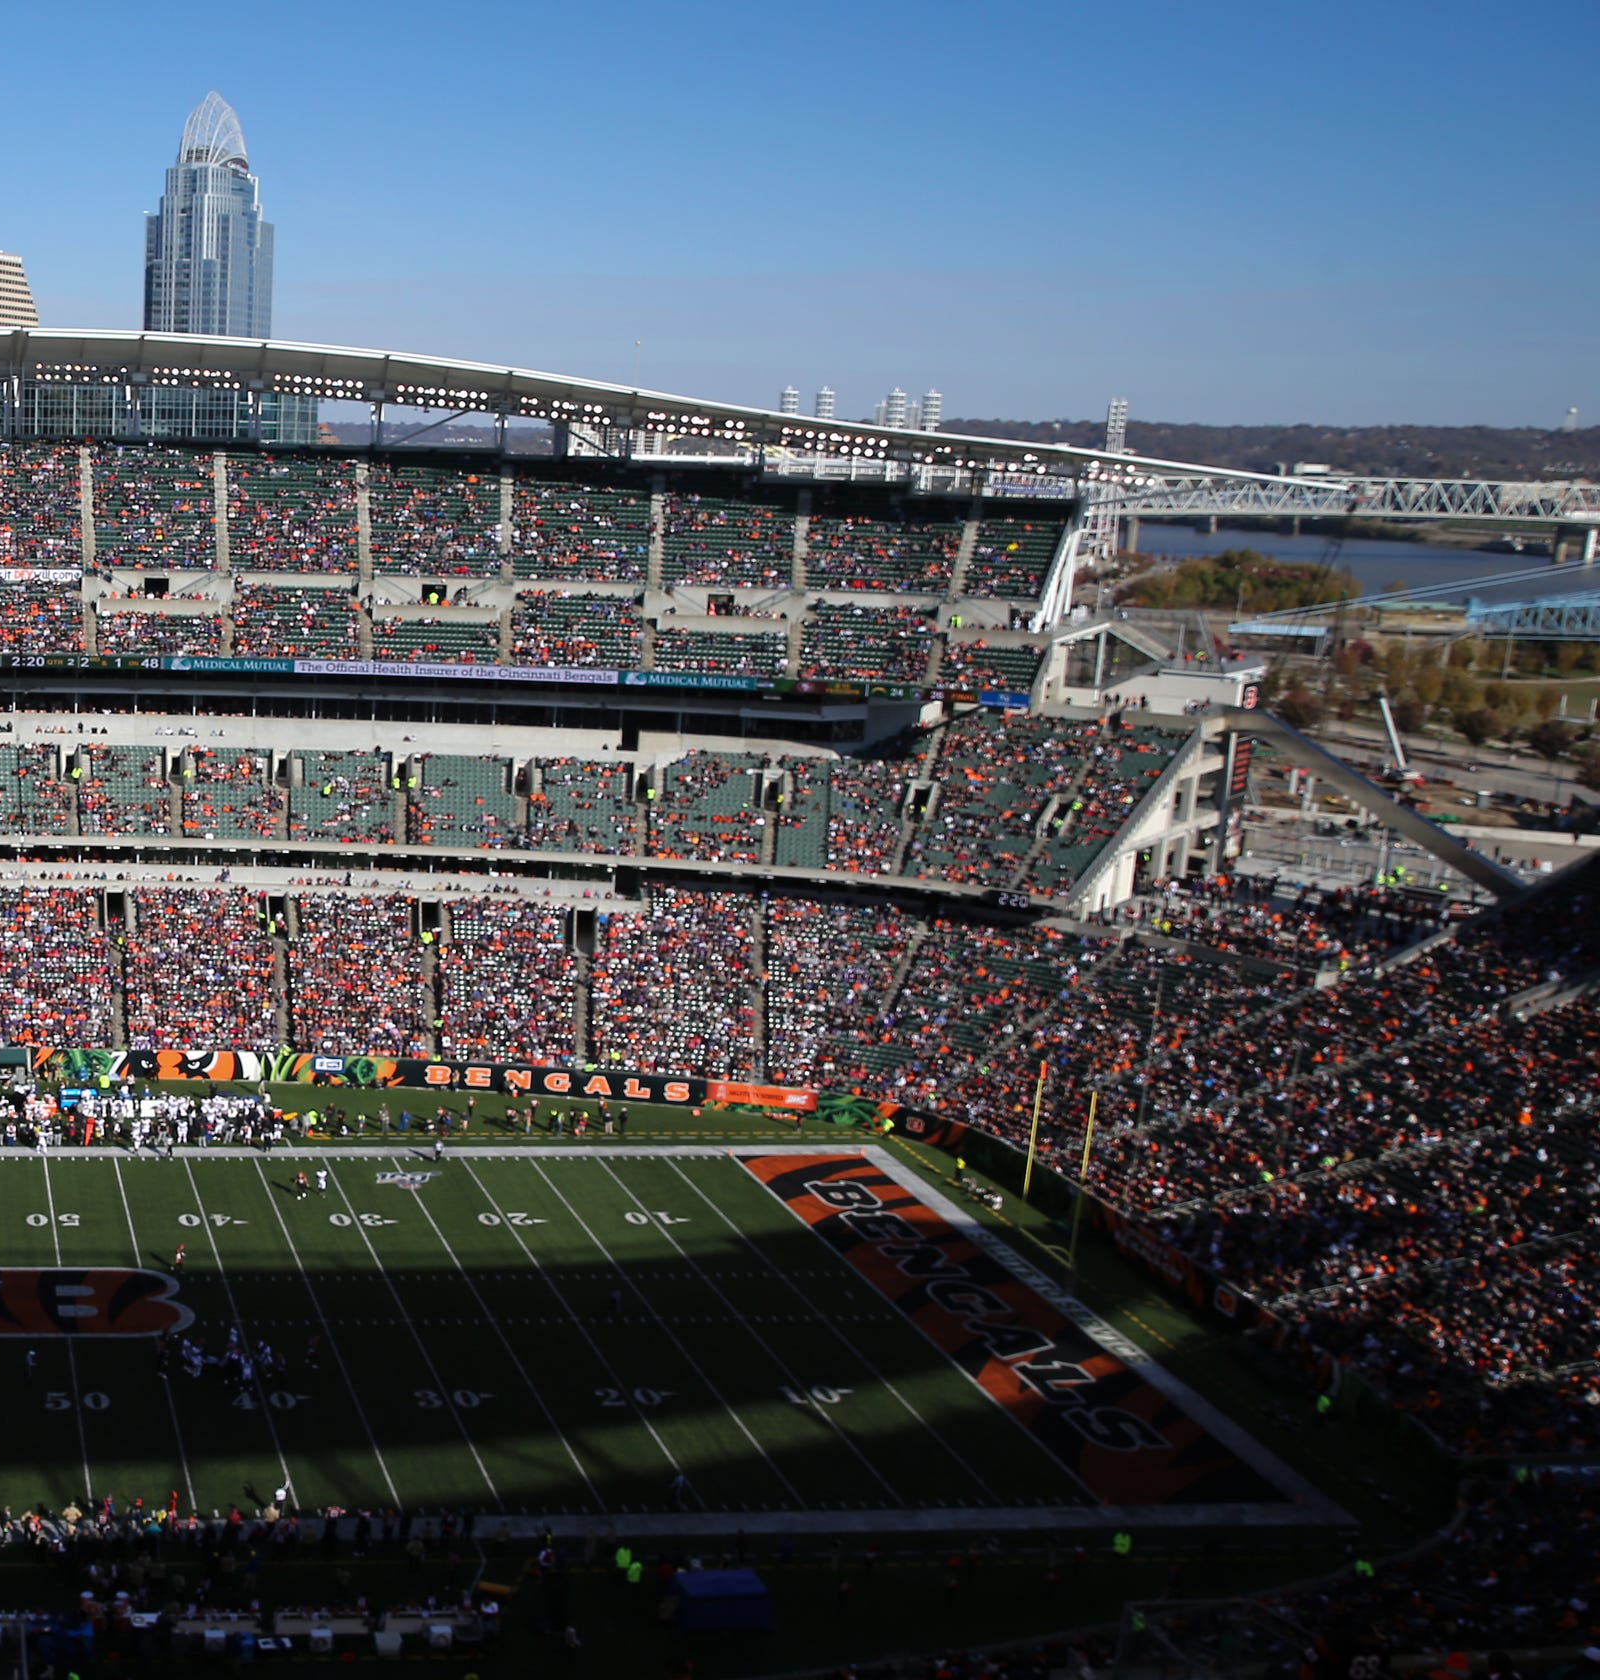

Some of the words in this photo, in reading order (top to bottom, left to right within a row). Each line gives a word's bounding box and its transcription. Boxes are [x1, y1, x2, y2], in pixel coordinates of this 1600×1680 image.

[14, 570, 33, 579] DEY
[52, 571, 80, 580] come
[11, 656, 45, 667] 2:20
[67, 658, 75, 666] 2
[141, 659, 159, 668] 48
[193, 660, 241, 670] MEDICAL
[244, 661, 289, 671] MUTUAL
[301, 662, 322, 672] The
[328, 662, 369, 673] Official
[373, 664, 411, 675] Health
[415, 666, 458, 677] Insurer
[461, 667, 474, 676] of
[476, 668, 494, 677] the
[498, 669, 560, 681] Cincinnati
[564, 671, 613, 683] Bengals
[650, 675, 699, 686] MEDICAL
[702, 677, 749, 688] MUTUAL
[998, 892, 1029, 908] 2:20
[425, 1064, 691, 1102] BENGALS
[803, 1168, 1174, 1452] BENGALS
[45, 1391, 112, 1411] 50
[232, 1391, 297, 1411] 40
[414, 1389, 483, 1408] 30
[594, 1387, 663, 1407] 20
[776, 1384, 844, 1405] 10
